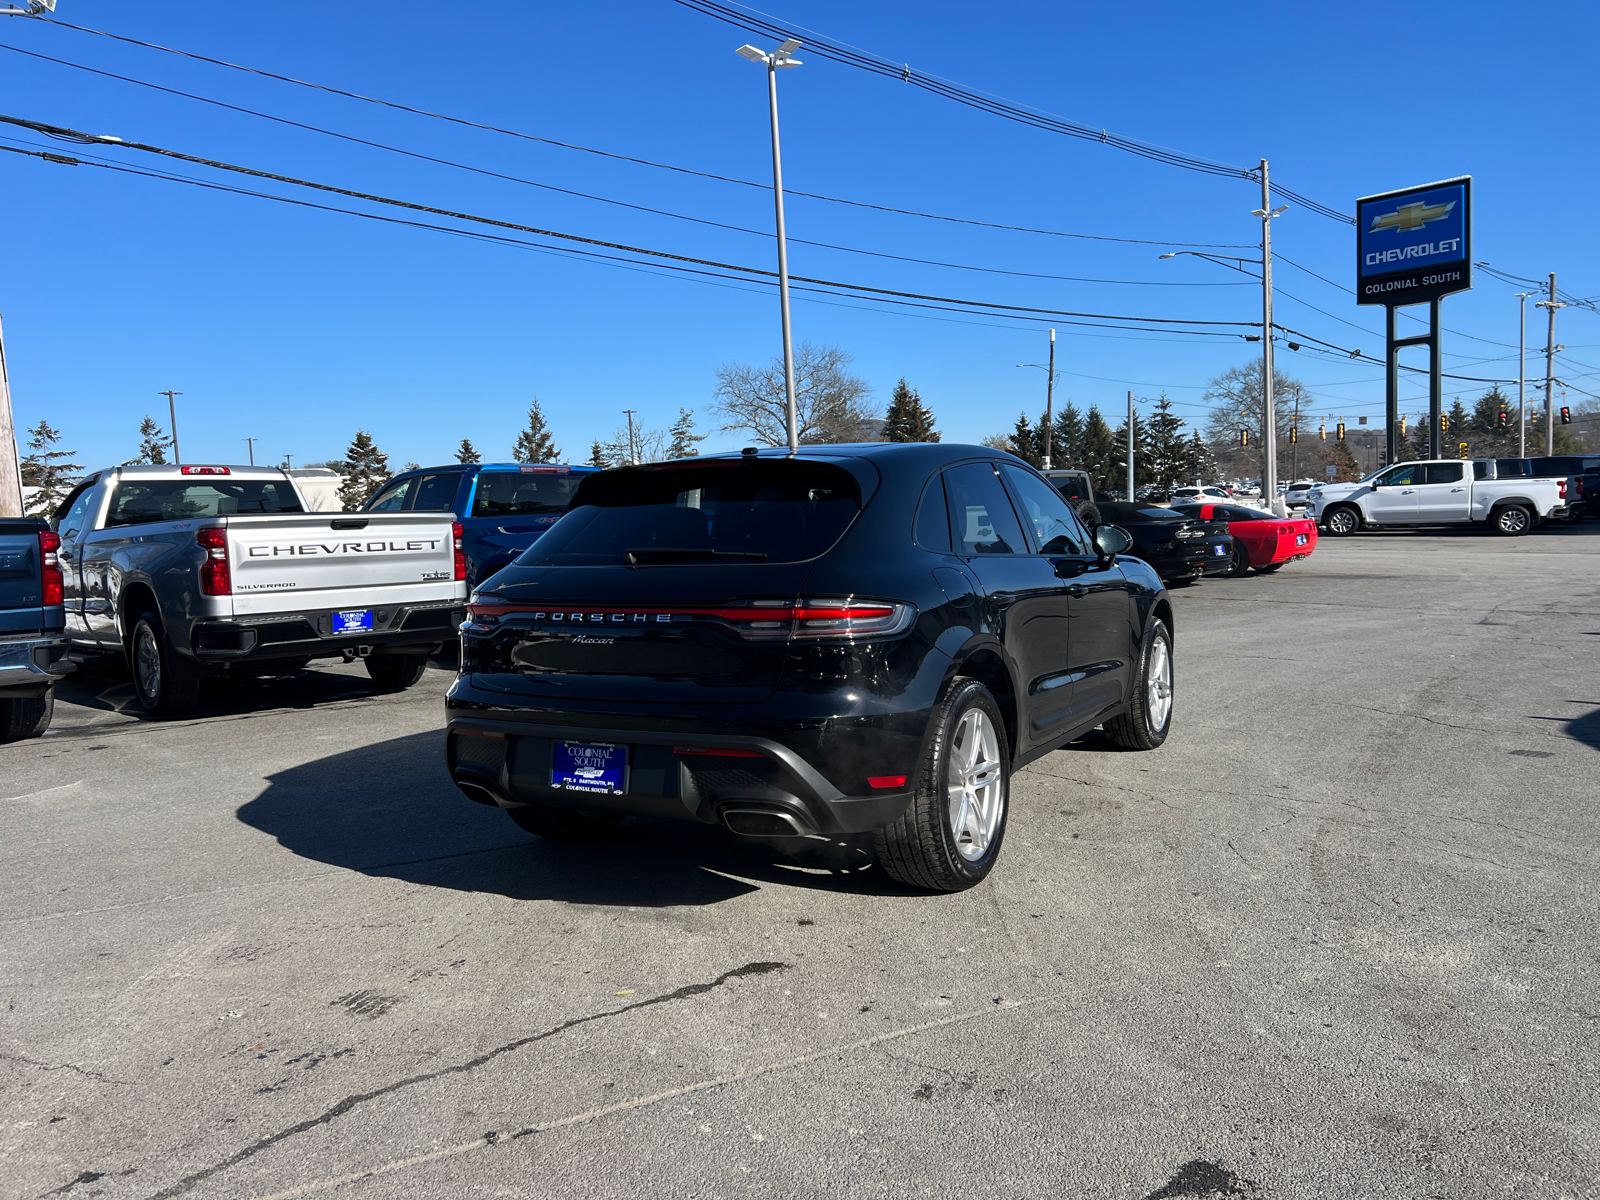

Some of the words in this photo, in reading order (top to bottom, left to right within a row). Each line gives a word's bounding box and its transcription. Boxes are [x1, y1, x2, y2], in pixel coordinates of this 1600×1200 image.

[1366, 238, 1460, 265] CHEVROLET
[1365, 278, 1418, 294] COLONIAL
[1422, 271, 1460, 286] SOUTH
[249, 540, 441, 557] CHEVROLET
[237, 582, 296, 590] SILVERADO
[535, 612, 672, 622] PORSCHE
[572, 634, 614, 644] Macan
[568, 746, 613, 759] COLONIAL
[574, 757, 605, 767] SOUTH
[566, 784, 590, 792] COLONIAL
